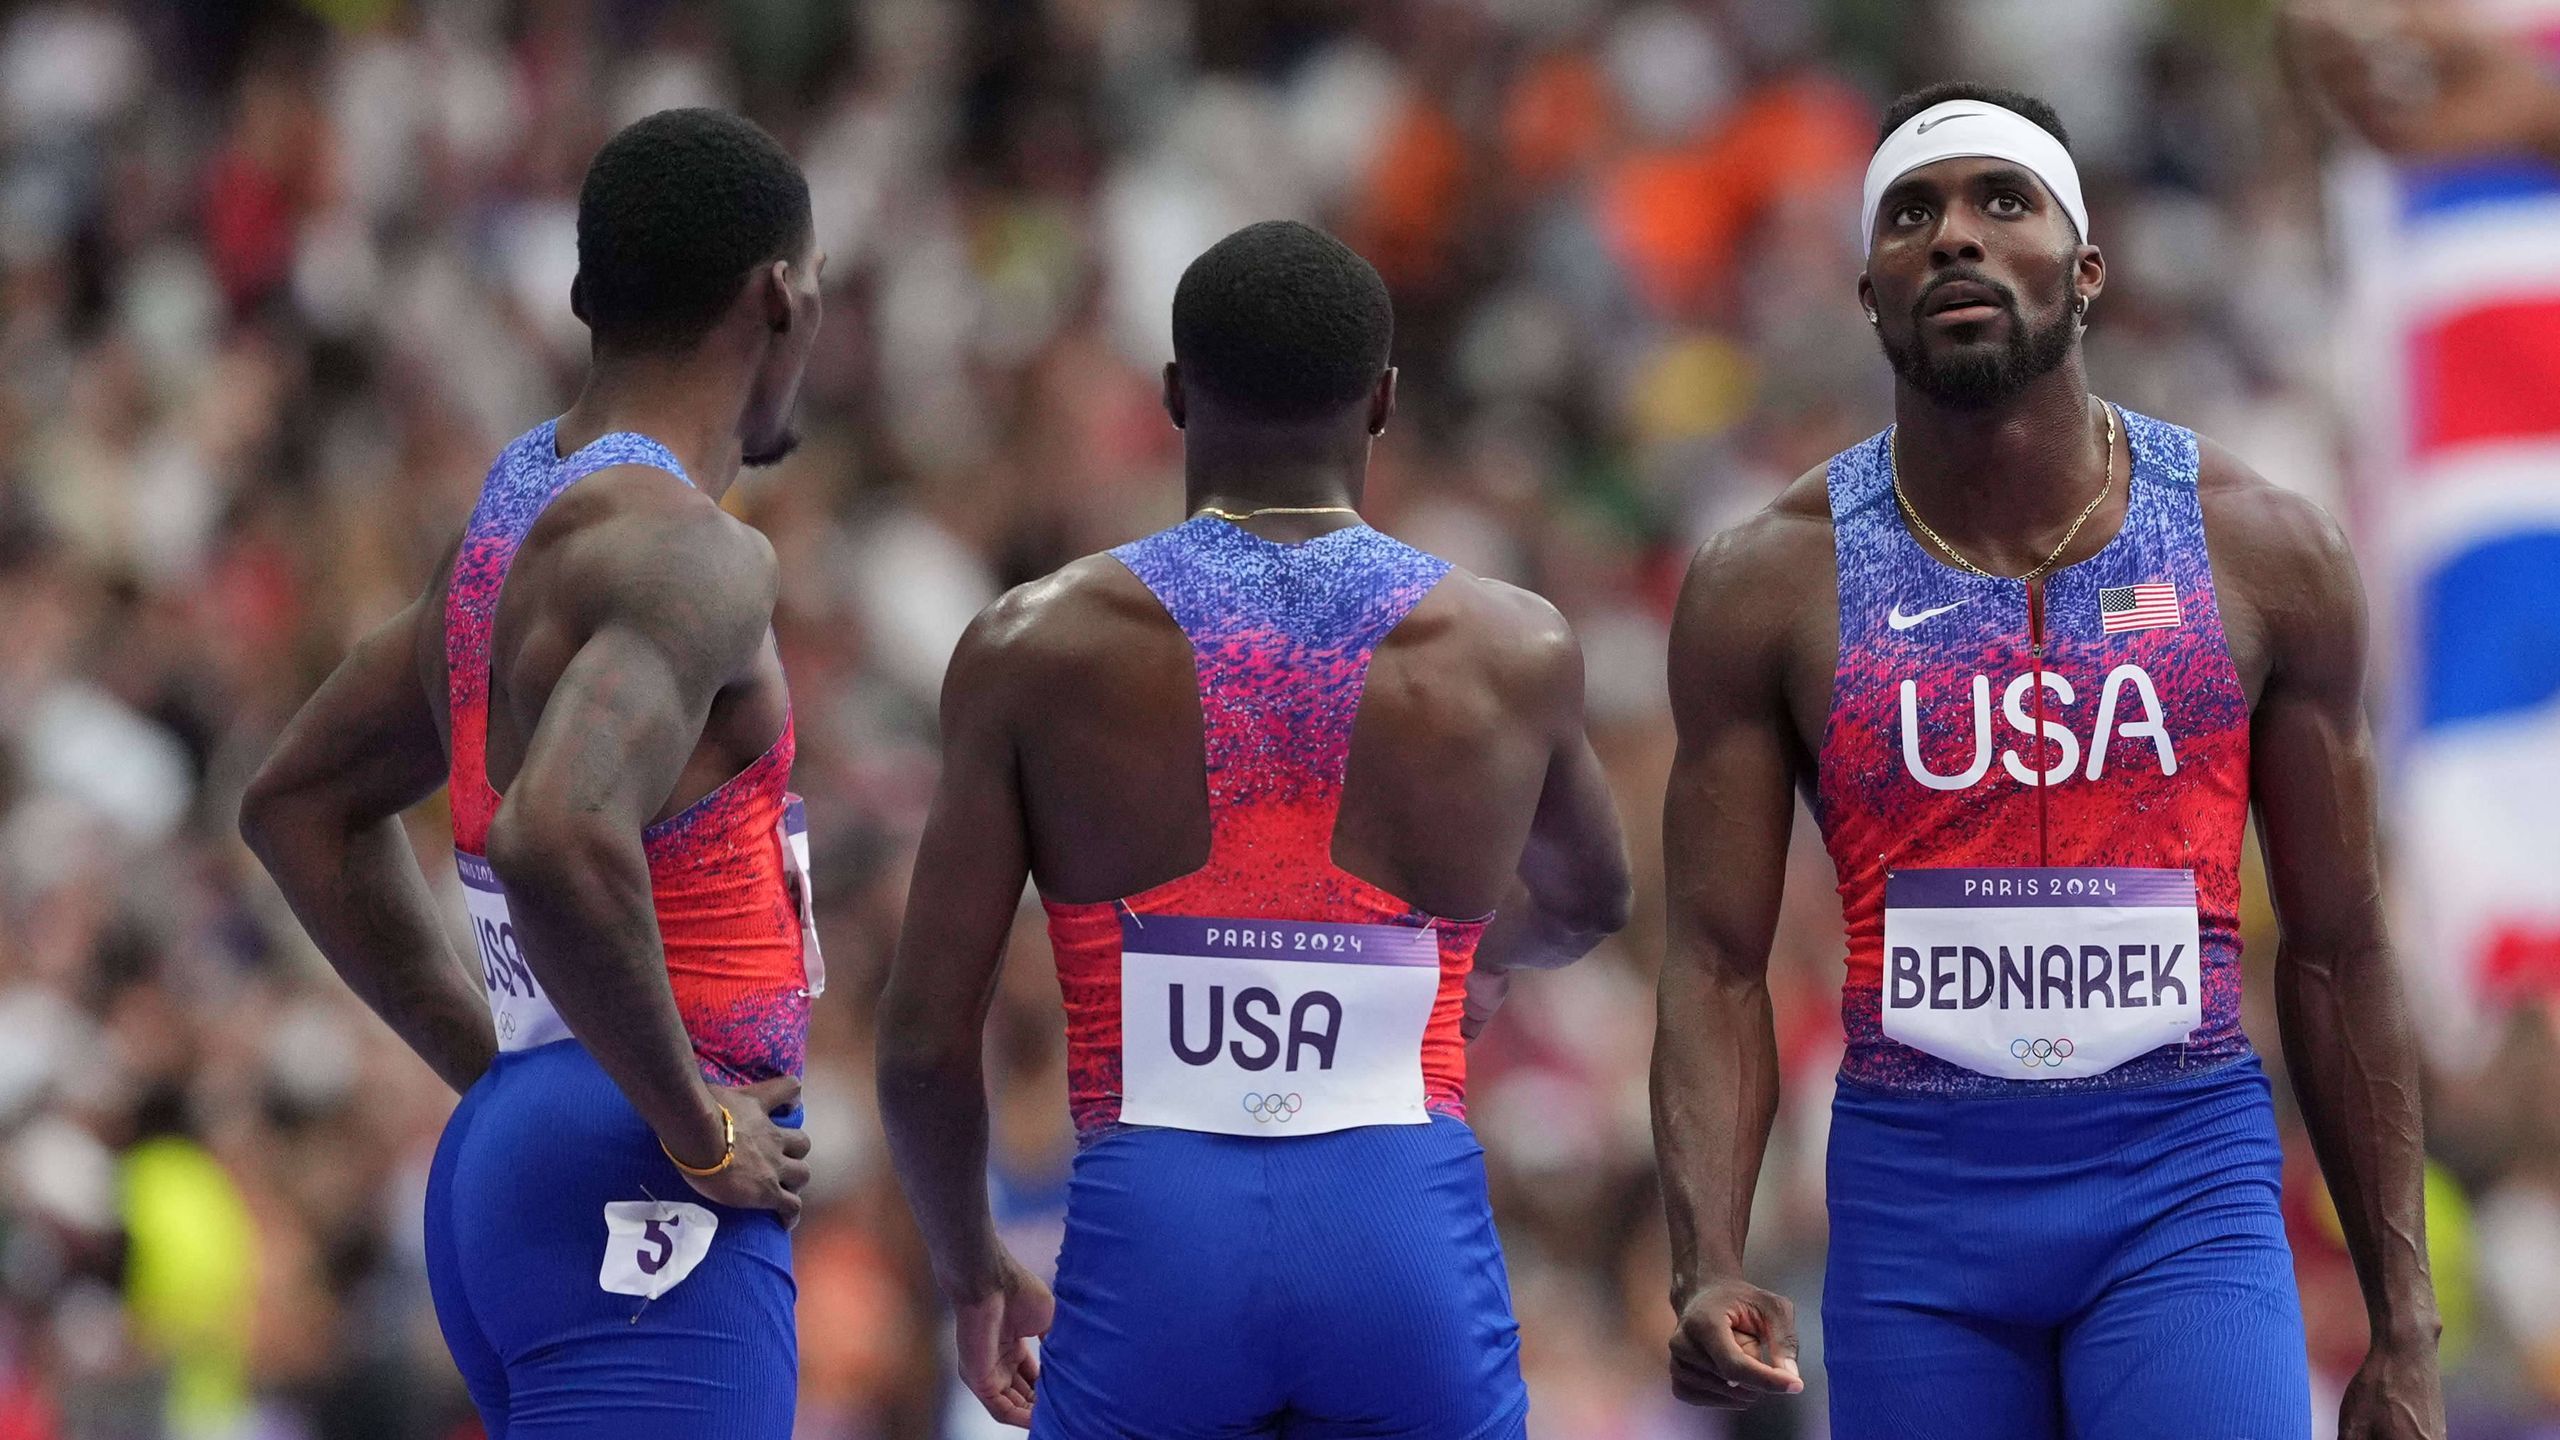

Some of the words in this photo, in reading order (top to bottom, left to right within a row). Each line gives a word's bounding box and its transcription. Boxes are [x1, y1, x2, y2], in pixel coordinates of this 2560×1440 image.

[1900, 664, 2178, 791] USA
[2049, 878, 2116, 896] 2024
[470, 914, 536, 998] USA
[1293, 931, 1362, 953] 2024
[1890, 944, 2187, 1010] BEDNAREK
[1169, 983, 1343, 1072] USA
[636, 1214, 680, 1276] 5
